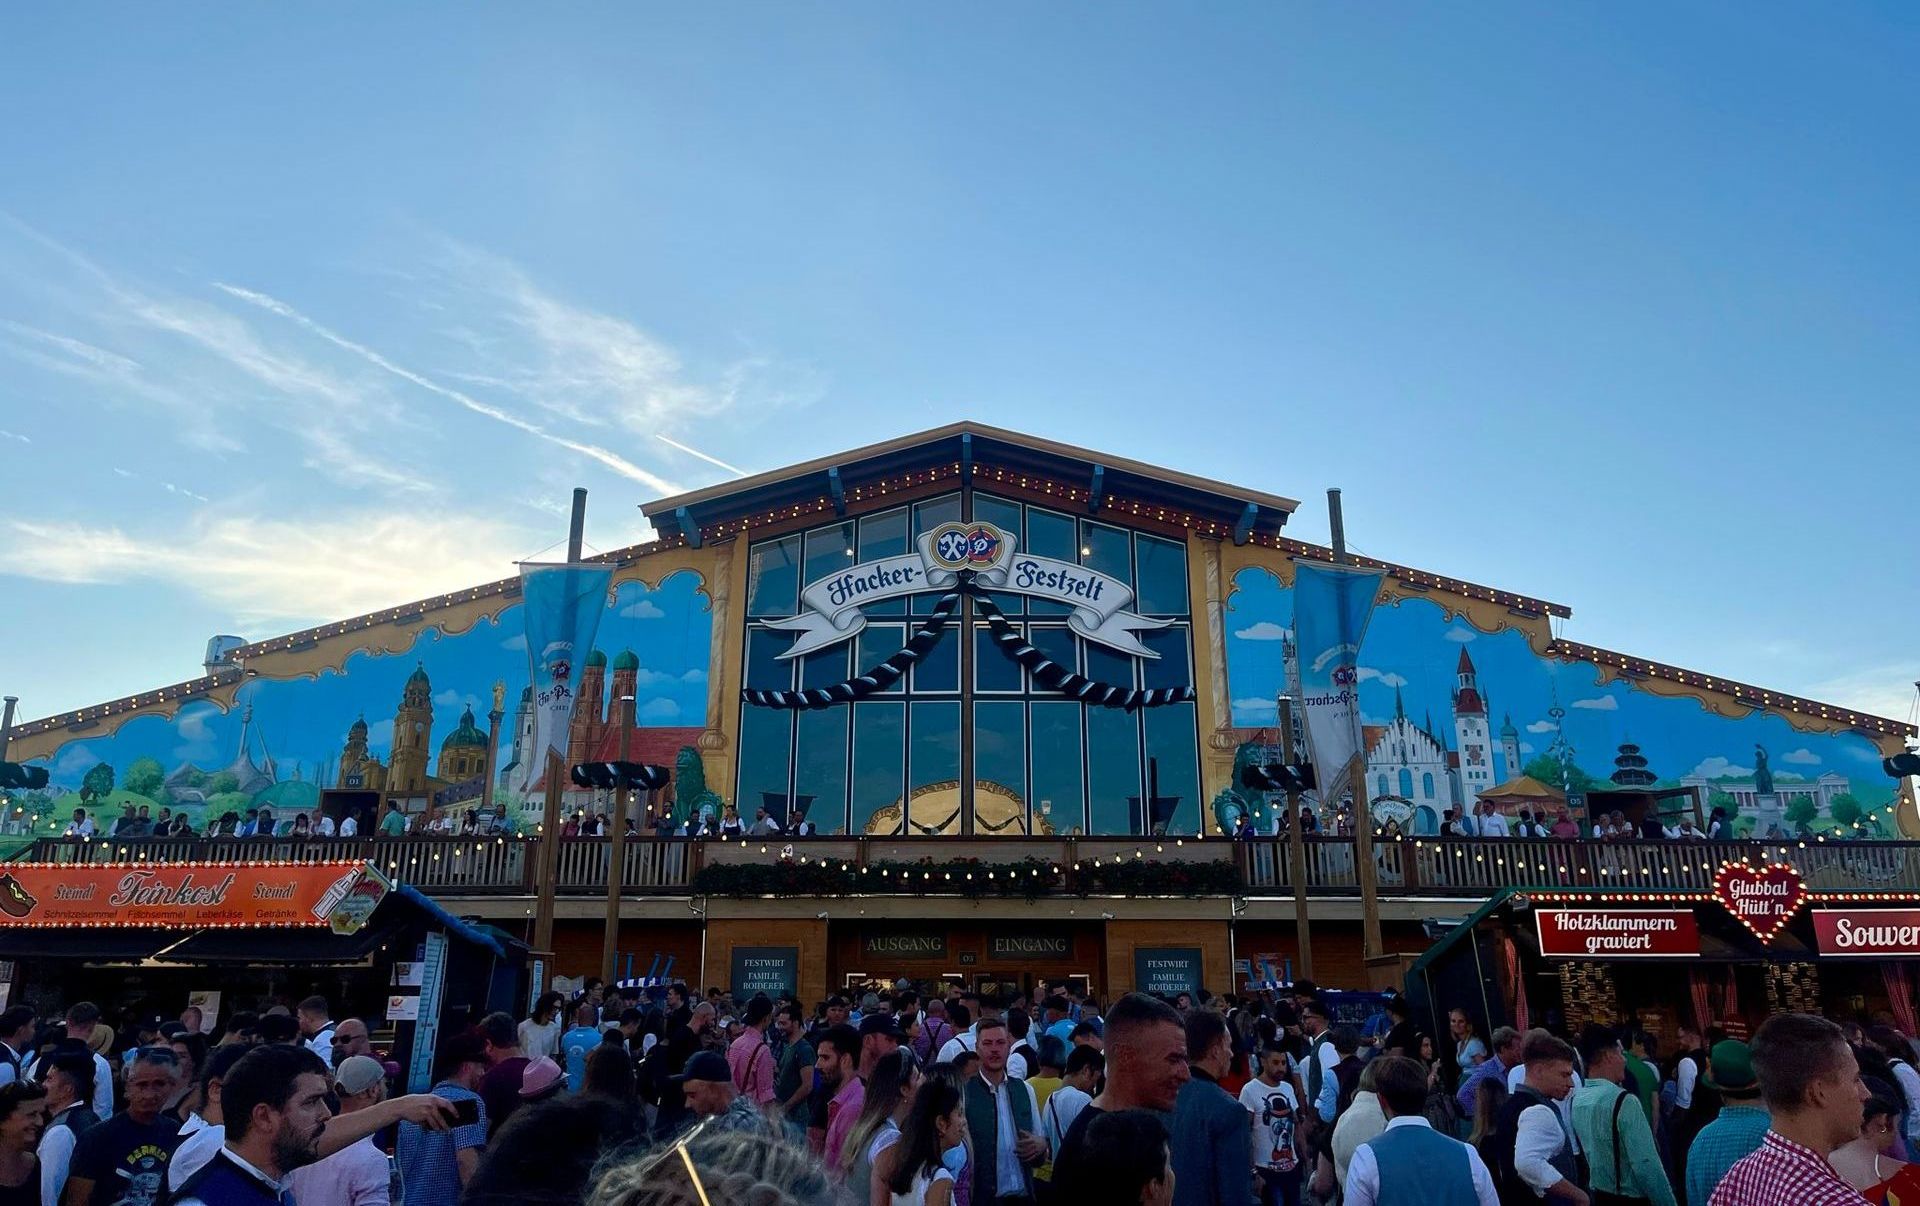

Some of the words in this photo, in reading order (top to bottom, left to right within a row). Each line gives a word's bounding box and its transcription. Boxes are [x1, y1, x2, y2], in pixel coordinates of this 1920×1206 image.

[827, 565, 923, 606] Hacker-
[1016, 560, 1104, 601] Festzelt
[54, 882, 96, 901] Steindl
[109, 870, 236, 906] Feinkost
[252, 881, 297, 901] Steindl
[1729, 878, 1789, 899] Glubbal
[196, 909, 244, 919] Leberkäse
[255, 909, 298, 918] Getränke
[1554, 913, 1677, 931] Holzklammern
[866, 936, 942, 951] AUSGANG
[995, 937, 1066, 952] EINGANG
[1585, 932, 1652, 954] graviert
[744, 959, 785, 967] FESTWIRT
[1147, 960, 1190, 968] FESTWIRT
[748, 972, 780, 980] FAMILIE
[1152, 973, 1185, 981] FAMILIE
[743, 982, 785, 990] ROIDERER
[1148, 983, 1191, 991] ROIDERER
